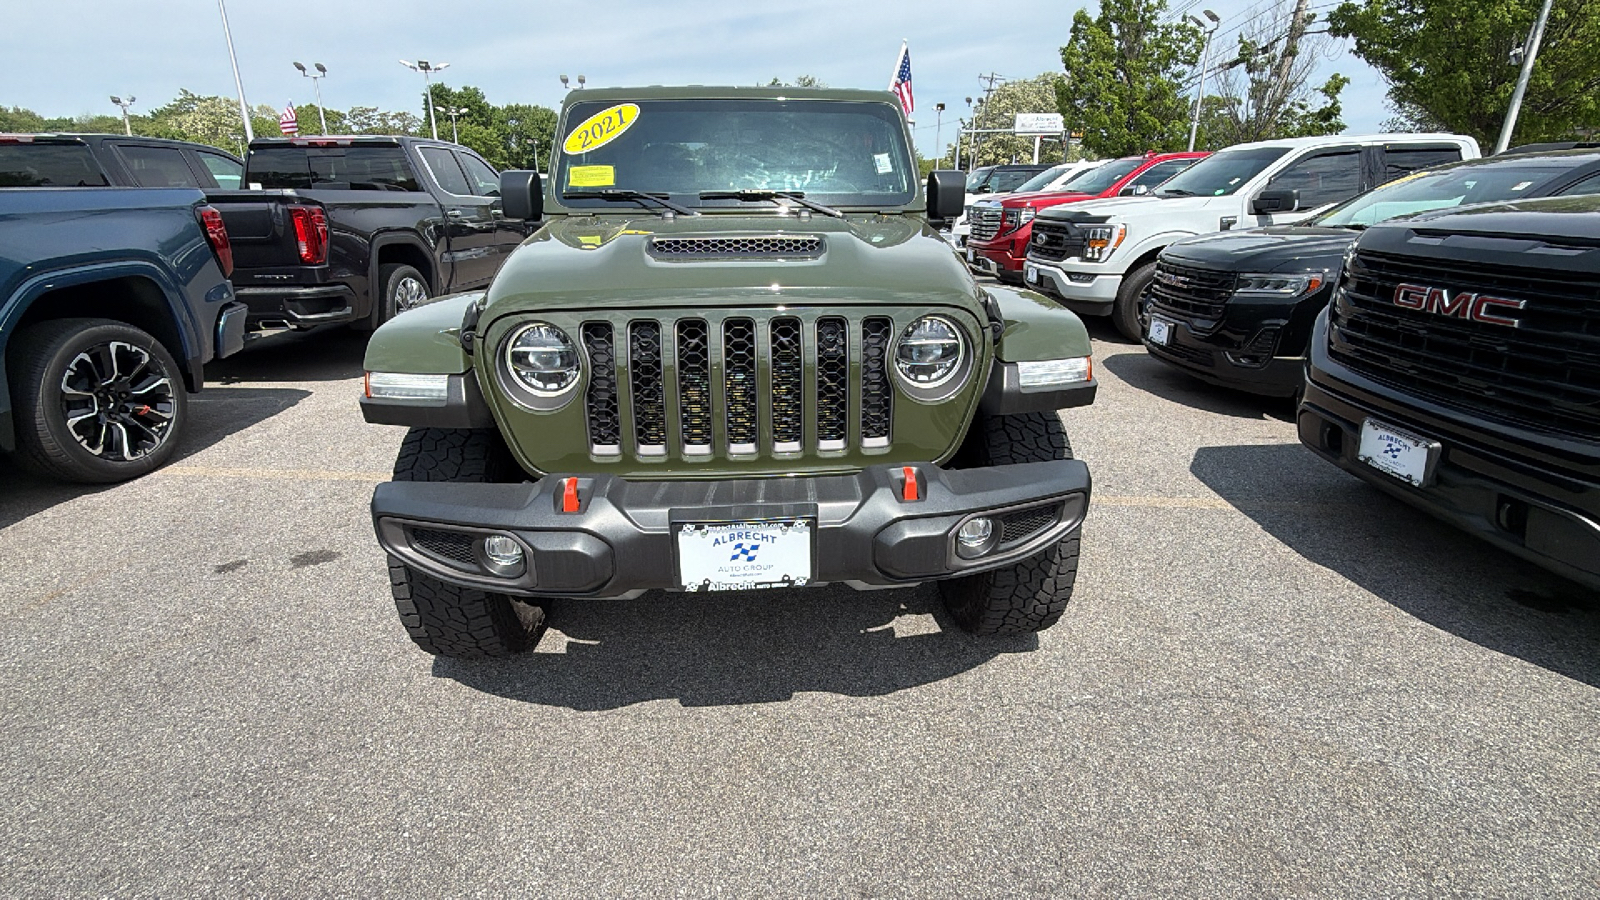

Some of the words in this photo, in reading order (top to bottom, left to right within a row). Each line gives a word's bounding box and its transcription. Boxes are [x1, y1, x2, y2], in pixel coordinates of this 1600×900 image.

[578, 108, 626, 149] 2021
[1393, 283, 1527, 328] GMC
[1378, 434, 1411, 453] ALBRECHT
[713, 531, 778, 547] ALBRECHT
[708, 581, 756, 592] Albrecht
